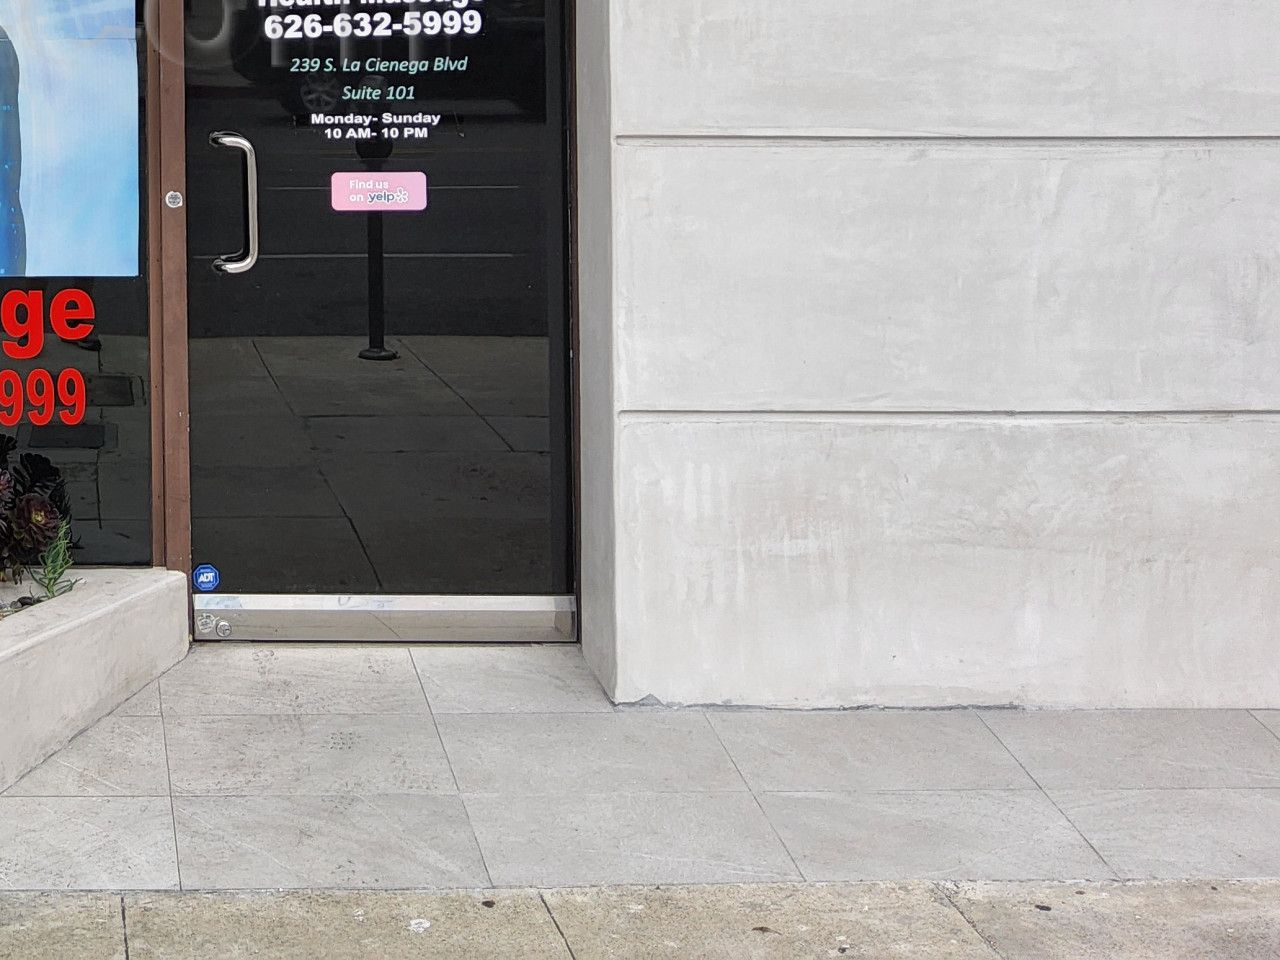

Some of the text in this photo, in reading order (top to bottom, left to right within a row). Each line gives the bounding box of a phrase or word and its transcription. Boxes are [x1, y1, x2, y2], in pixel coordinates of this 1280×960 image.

[264, 10, 482, 39] 626-632-5999
[290, 56, 468, 74] 239 S. La Cienega Blvd
[342, 86, 415, 100] Suite 101
[311, 113, 441, 126] Monday- Sunday
[324, 126, 342, 139] 10
[381, 126, 400, 138] 10
[404, 125, 428, 138] PM
[349, 179, 389, 189] Find us
[349, 191, 395, 203] on yelp
[198, 572, 215, 583] ADT
